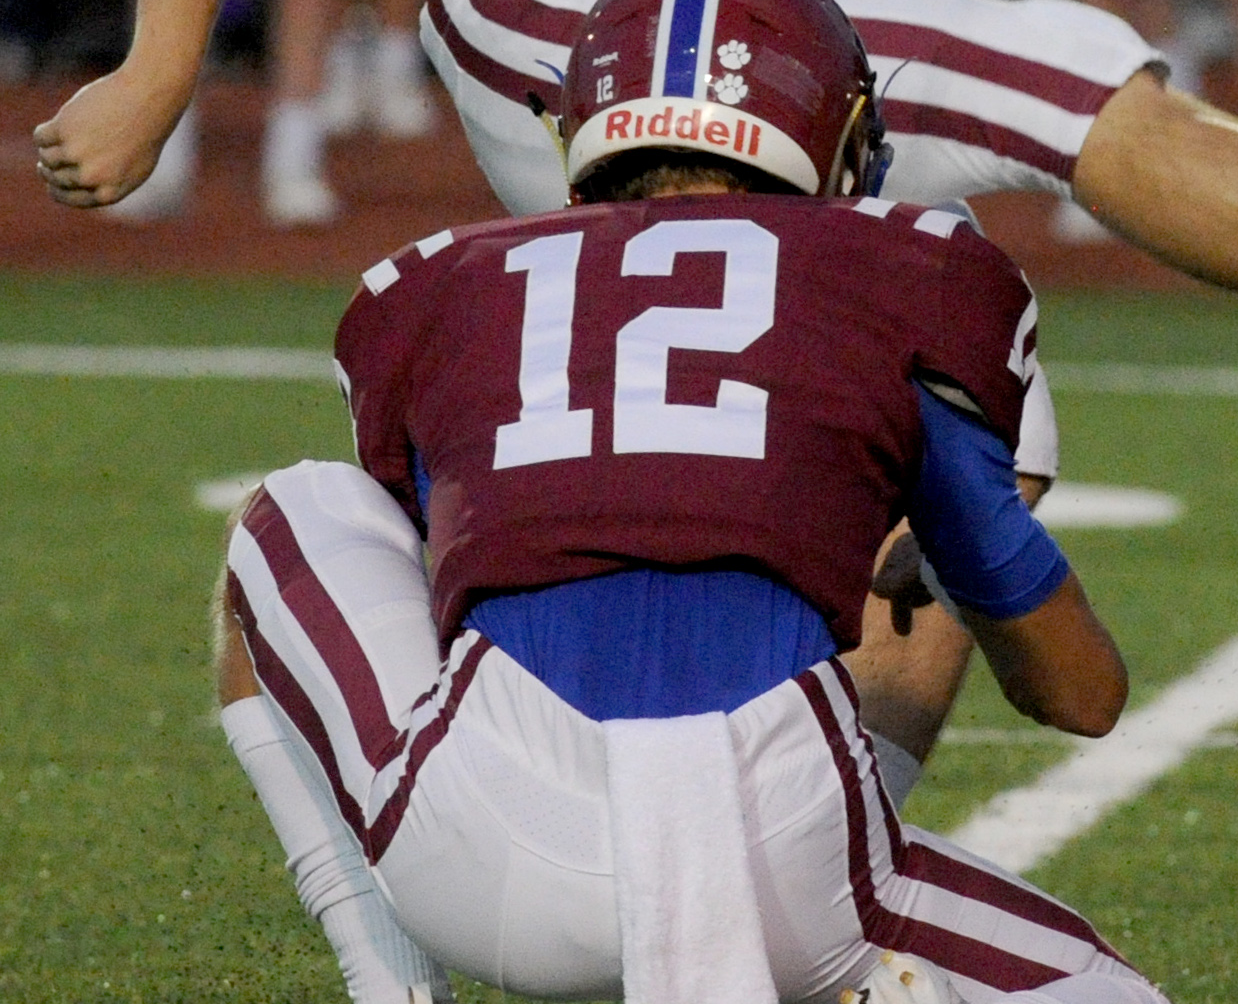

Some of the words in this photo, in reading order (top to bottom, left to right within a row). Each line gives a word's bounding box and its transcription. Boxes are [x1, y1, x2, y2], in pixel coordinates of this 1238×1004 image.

[596, 74, 613, 104] 12
[605, 106, 761, 157] Riddell
[493, 219, 779, 470] 12
